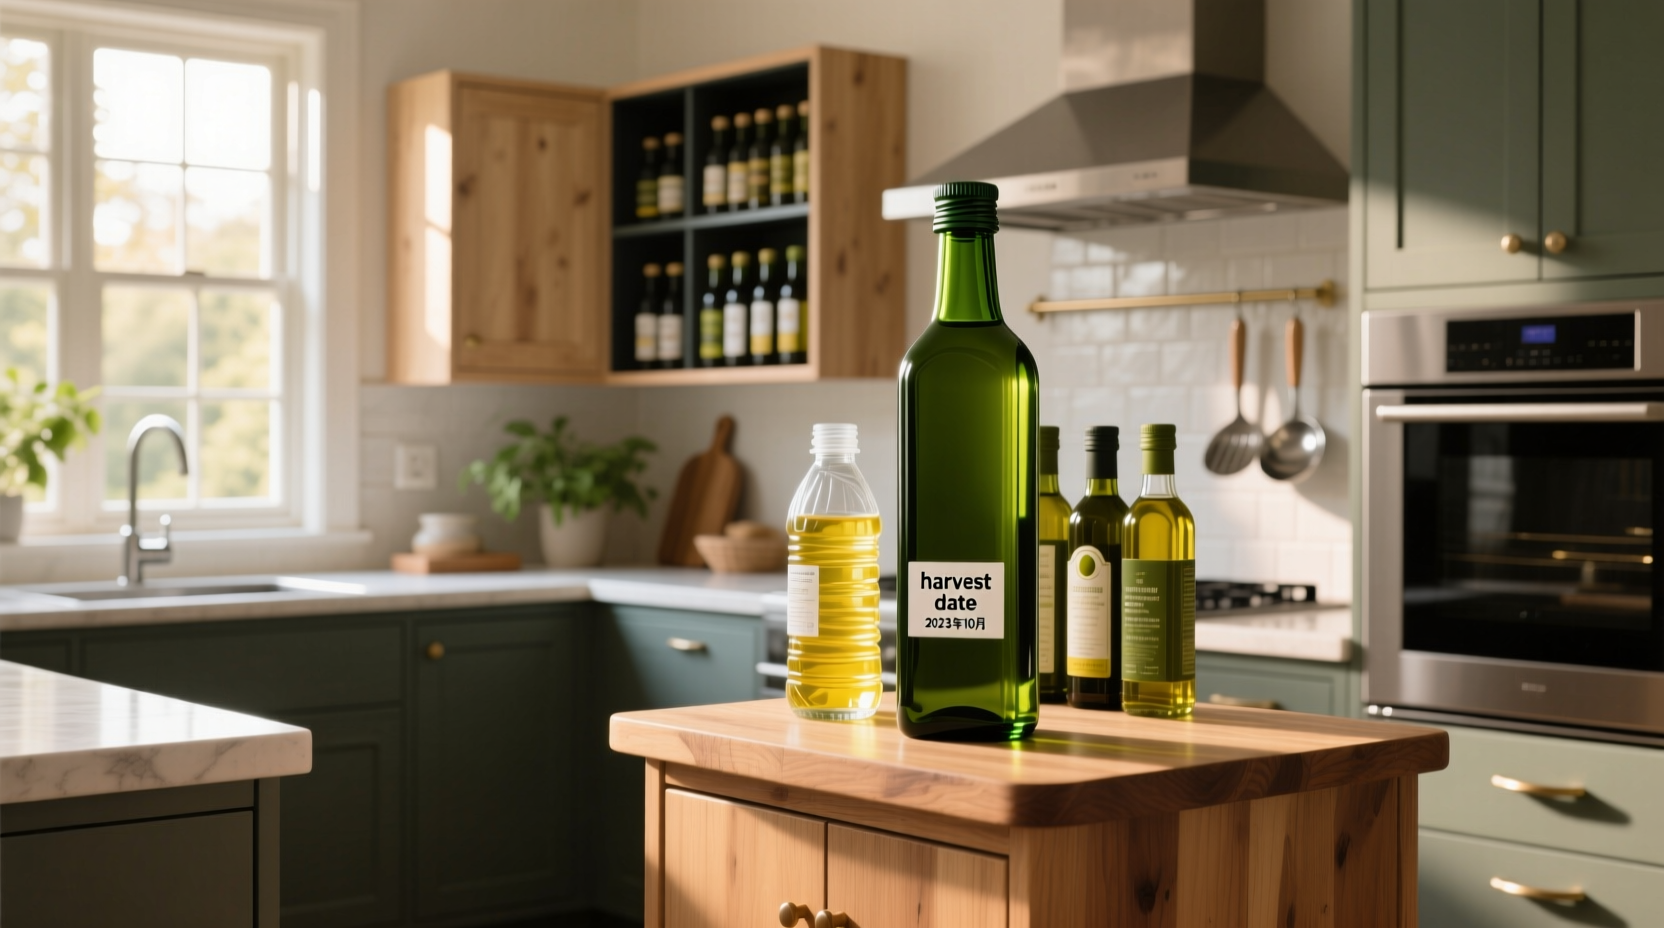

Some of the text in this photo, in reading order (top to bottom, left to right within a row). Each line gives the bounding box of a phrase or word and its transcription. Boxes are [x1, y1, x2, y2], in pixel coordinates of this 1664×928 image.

[921, 571, 991, 591] harvest
[935, 593, 977, 612] date
[924, 617, 985, 631] 2023年10月
